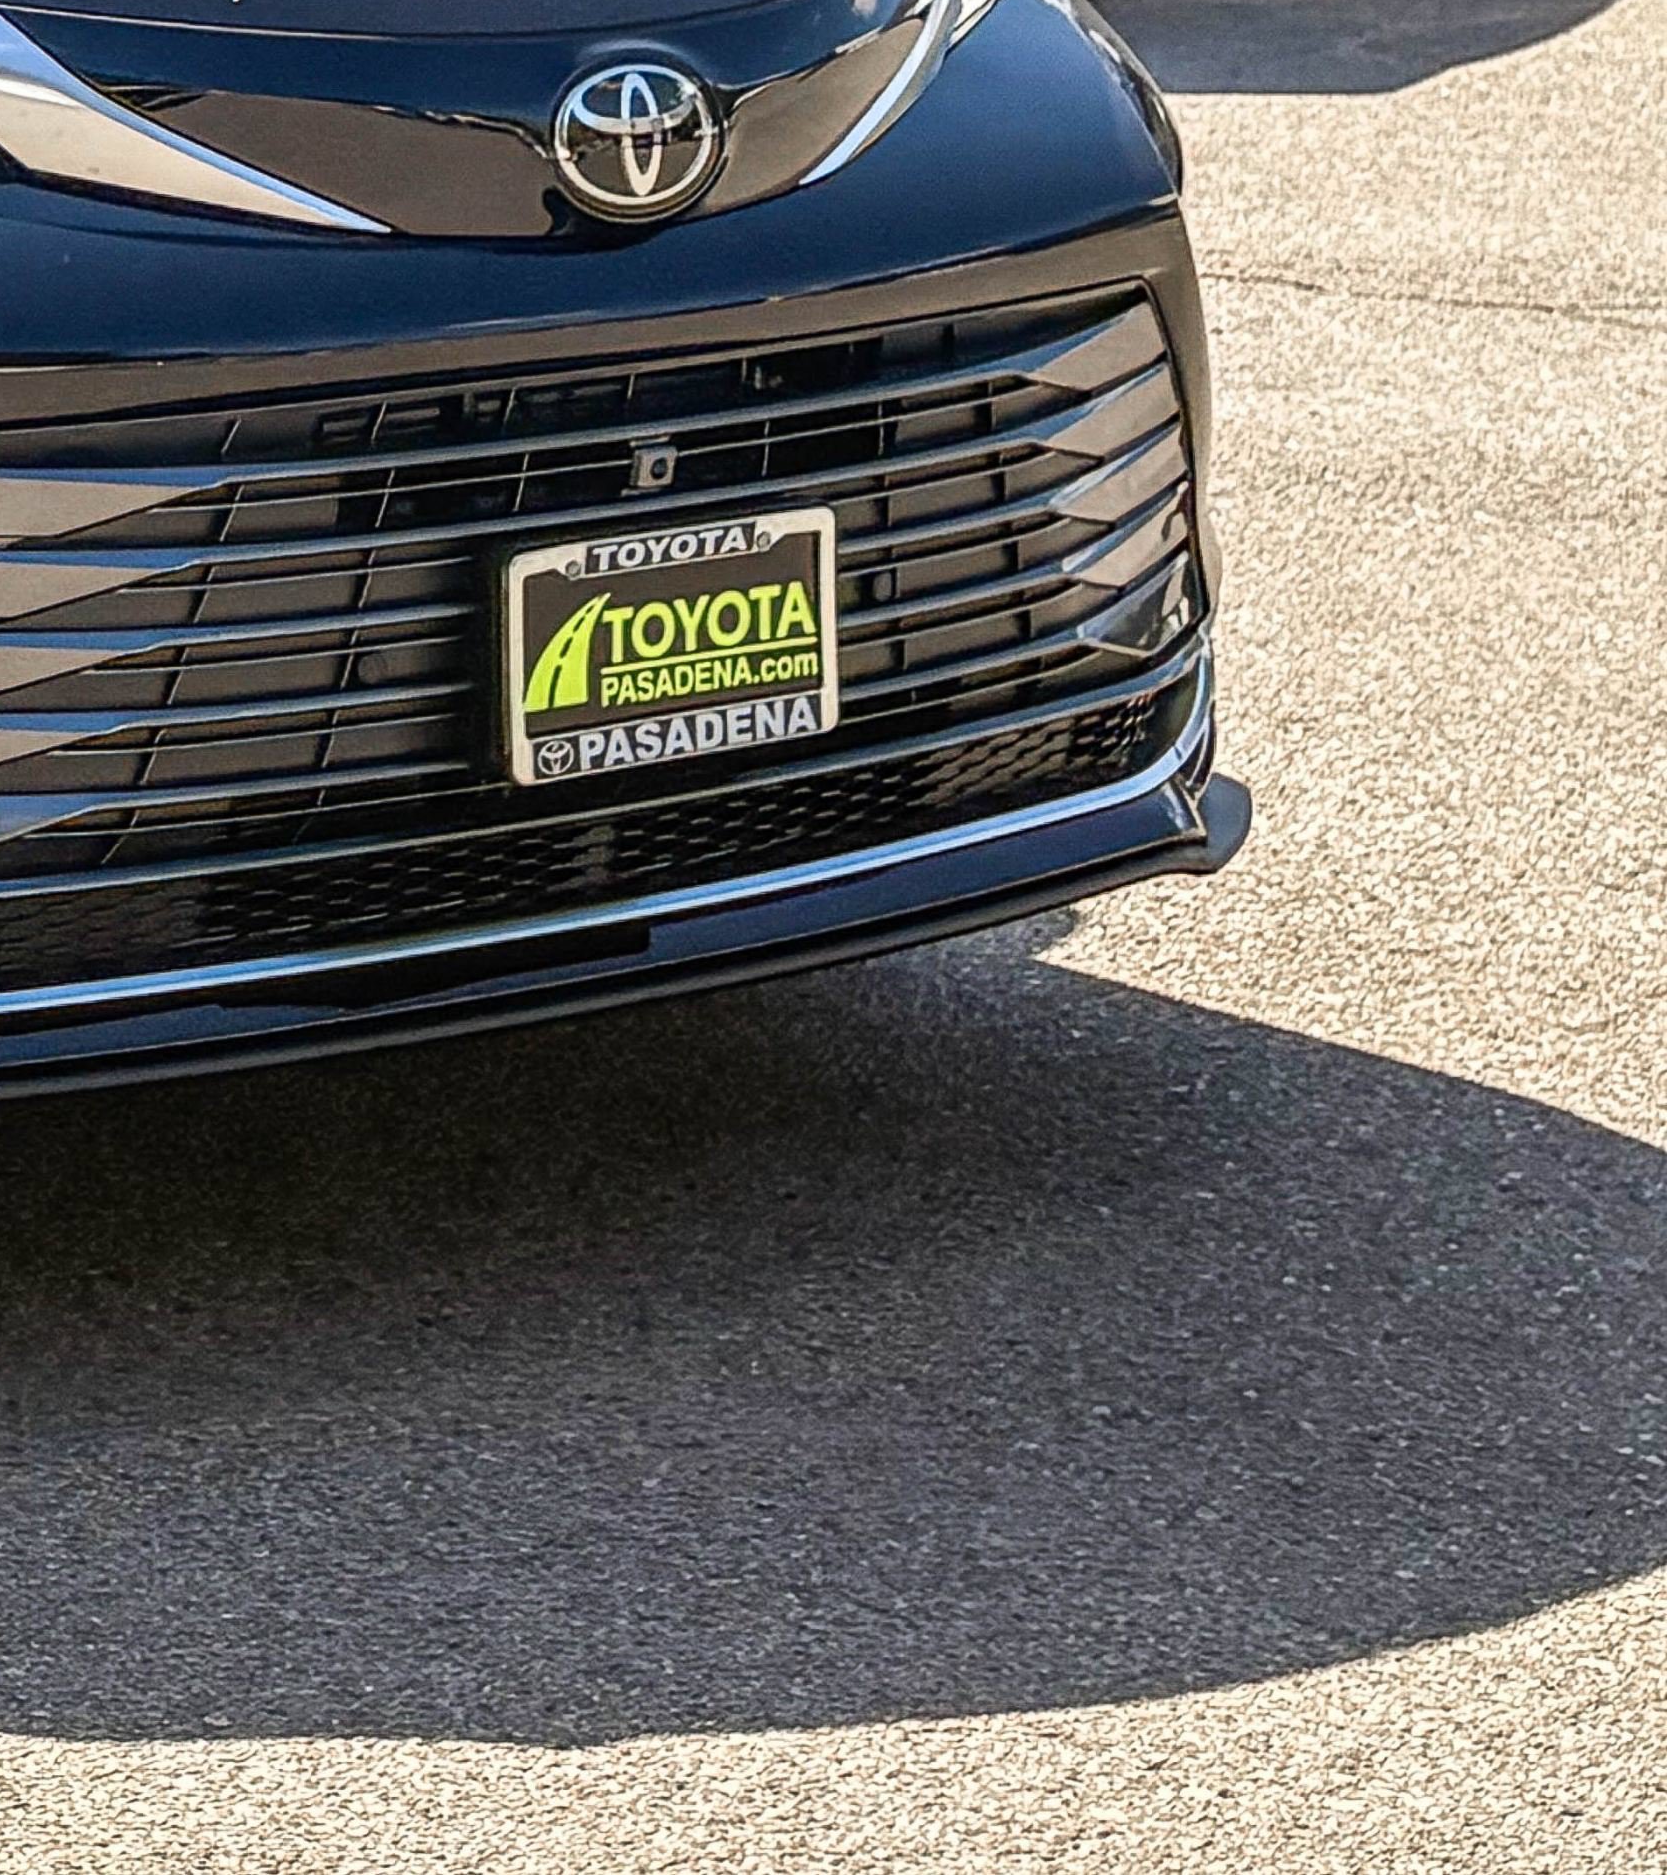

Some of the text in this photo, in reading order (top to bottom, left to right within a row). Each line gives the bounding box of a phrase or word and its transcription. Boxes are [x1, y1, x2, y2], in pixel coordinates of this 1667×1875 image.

[592, 527, 748, 572] TOYOTA
[601, 579, 816, 663] TOYOTA
[600, 651, 819, 708] PASADENA.com
[579, 696, 817, 770] PASADENA
